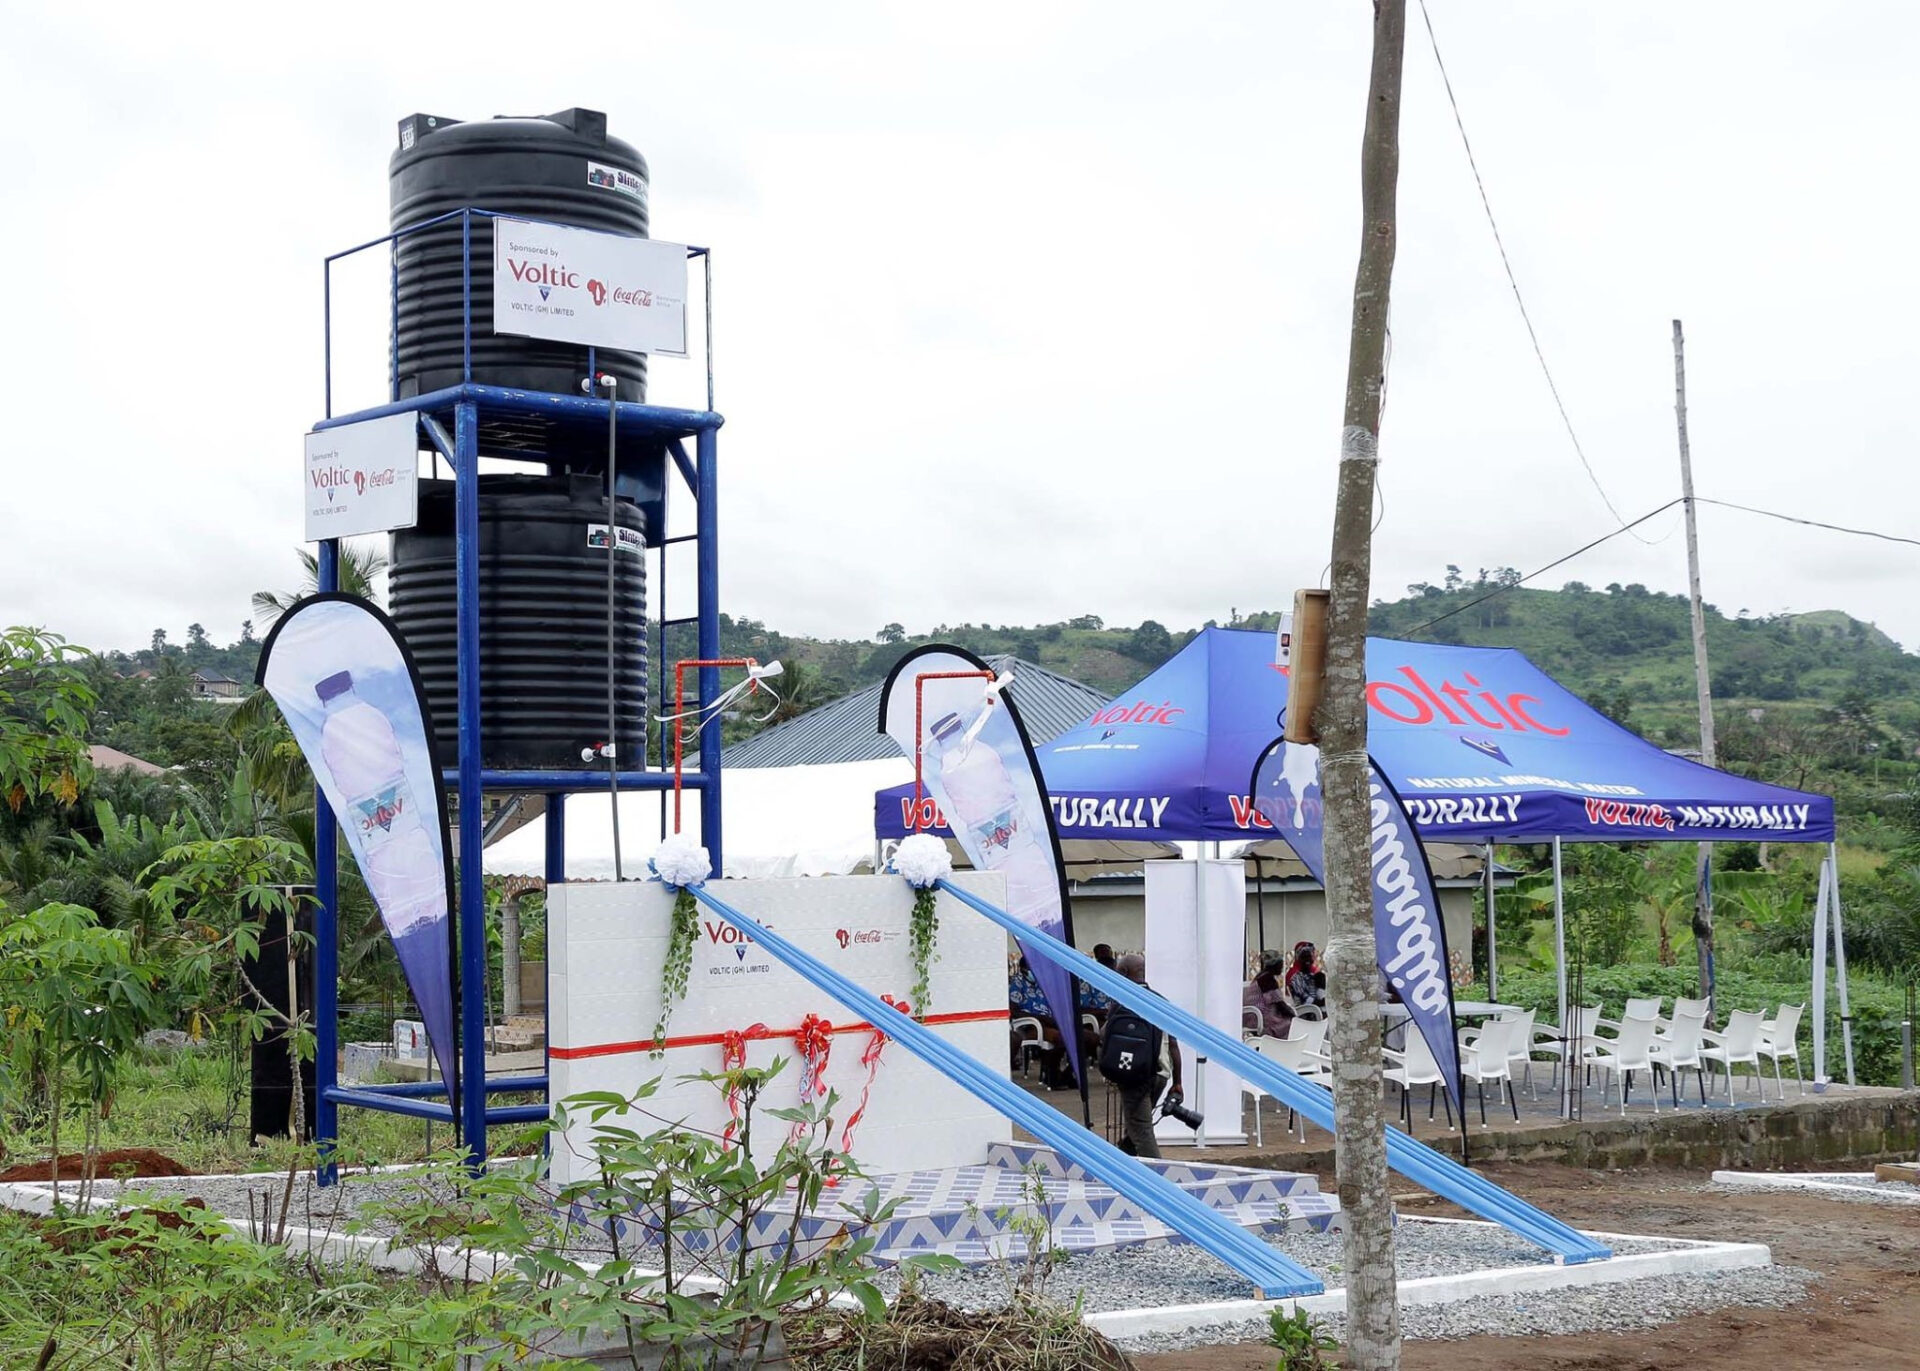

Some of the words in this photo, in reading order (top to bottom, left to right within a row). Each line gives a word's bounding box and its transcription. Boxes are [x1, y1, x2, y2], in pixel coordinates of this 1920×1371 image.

[509, 242, 549, 255] Sponsored
[550, 247, 559, 257] by
[507, 258, 580, 288] Voltic
[511, 302, 534, 312] VOLTIC
[550, 306, 575, 317] LIMITED
[311, 464, 350, 488] Voltic
[1090, 700, 1185, 727] Voltic
[1406, 776, 1503, 789] NATURAL
[1048, 796, 1170, 828] TURALLY
[1402, 794, 1521, 825] TURALLY
[1677, 804, 1809, 830] NATURALLY
[709, 966, 731, 975] VOLTIC
[746, 964, 770, 974] LIMITED
